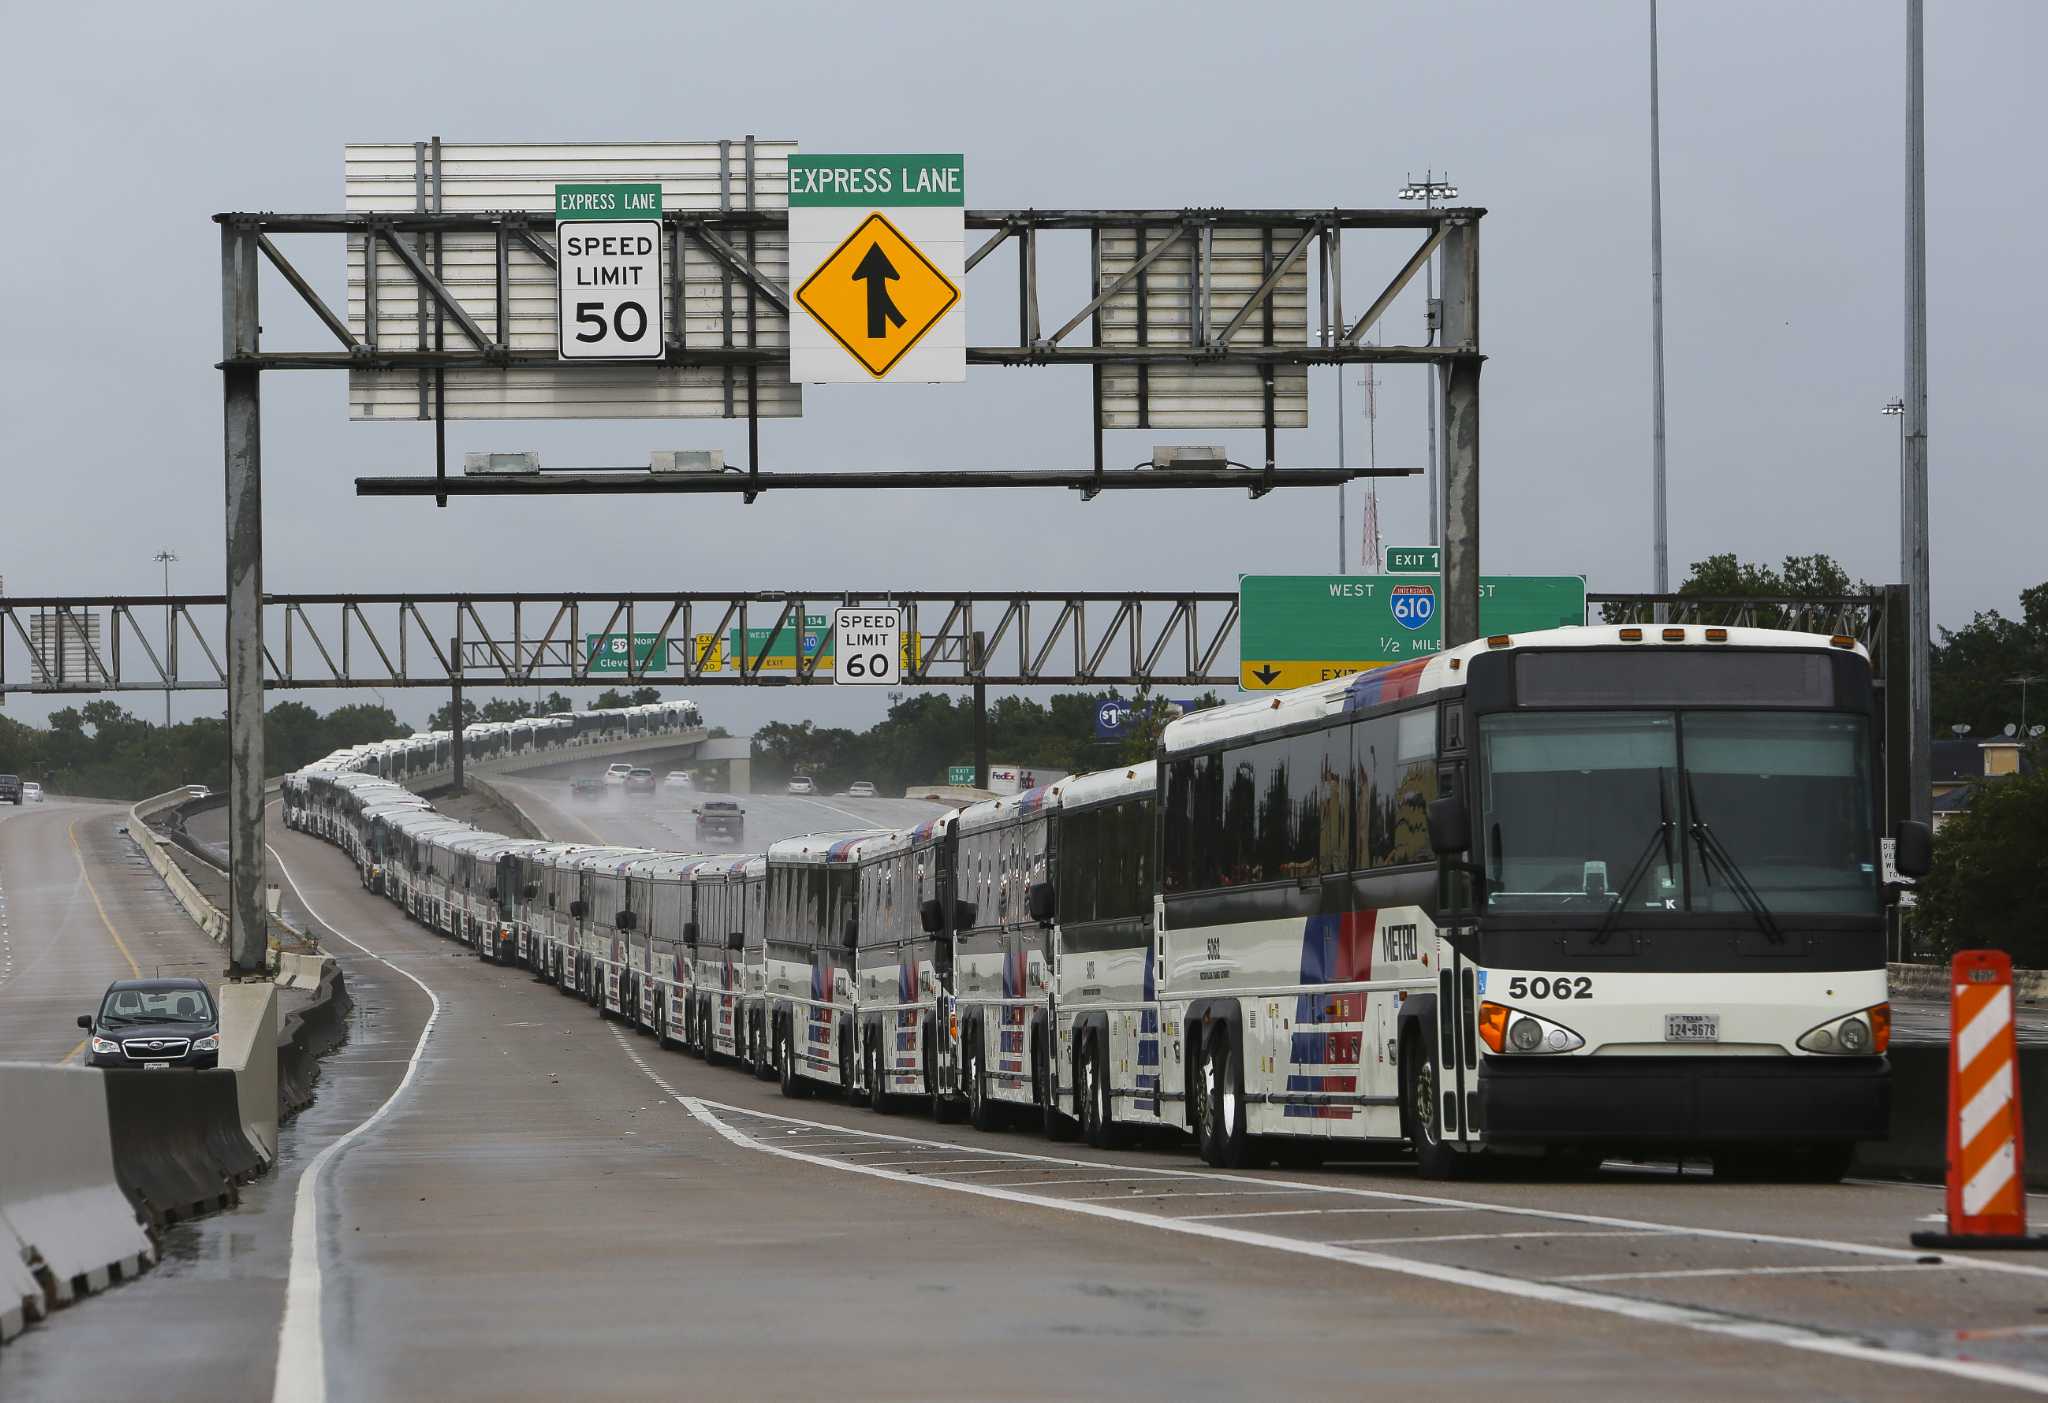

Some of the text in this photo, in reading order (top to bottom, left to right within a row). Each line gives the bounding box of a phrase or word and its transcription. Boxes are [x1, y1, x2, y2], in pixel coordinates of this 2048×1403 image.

[790, 167, 961, 193] EXPRESS LANE
[561, 193, 656, 210] EXPRESS LANE
[567, 236, 653, 256] SPEED
[577, 266, 643, 285] LIMIT
[575, 301, 648, 343] 50
[1395, 554, 1425, 565] EXIT
[1329, 584, 1374, 597] WEST
[1478, 585, 1496, 597] ST
[1395, 597, 1431, 618] 610
[840, 615, 896, 628] SPEED
[634, 637, 656, 645] NORT
[846, 634, 889, 646] LIMIT
[847, 653, 889, 678] 60
[992, 771, 1016, 781] FedEx
[1665, 899, 1677, 910] K
[1382, 923, 1418, 962] METRO
[1508, 976, 1593, 1000] 5062
